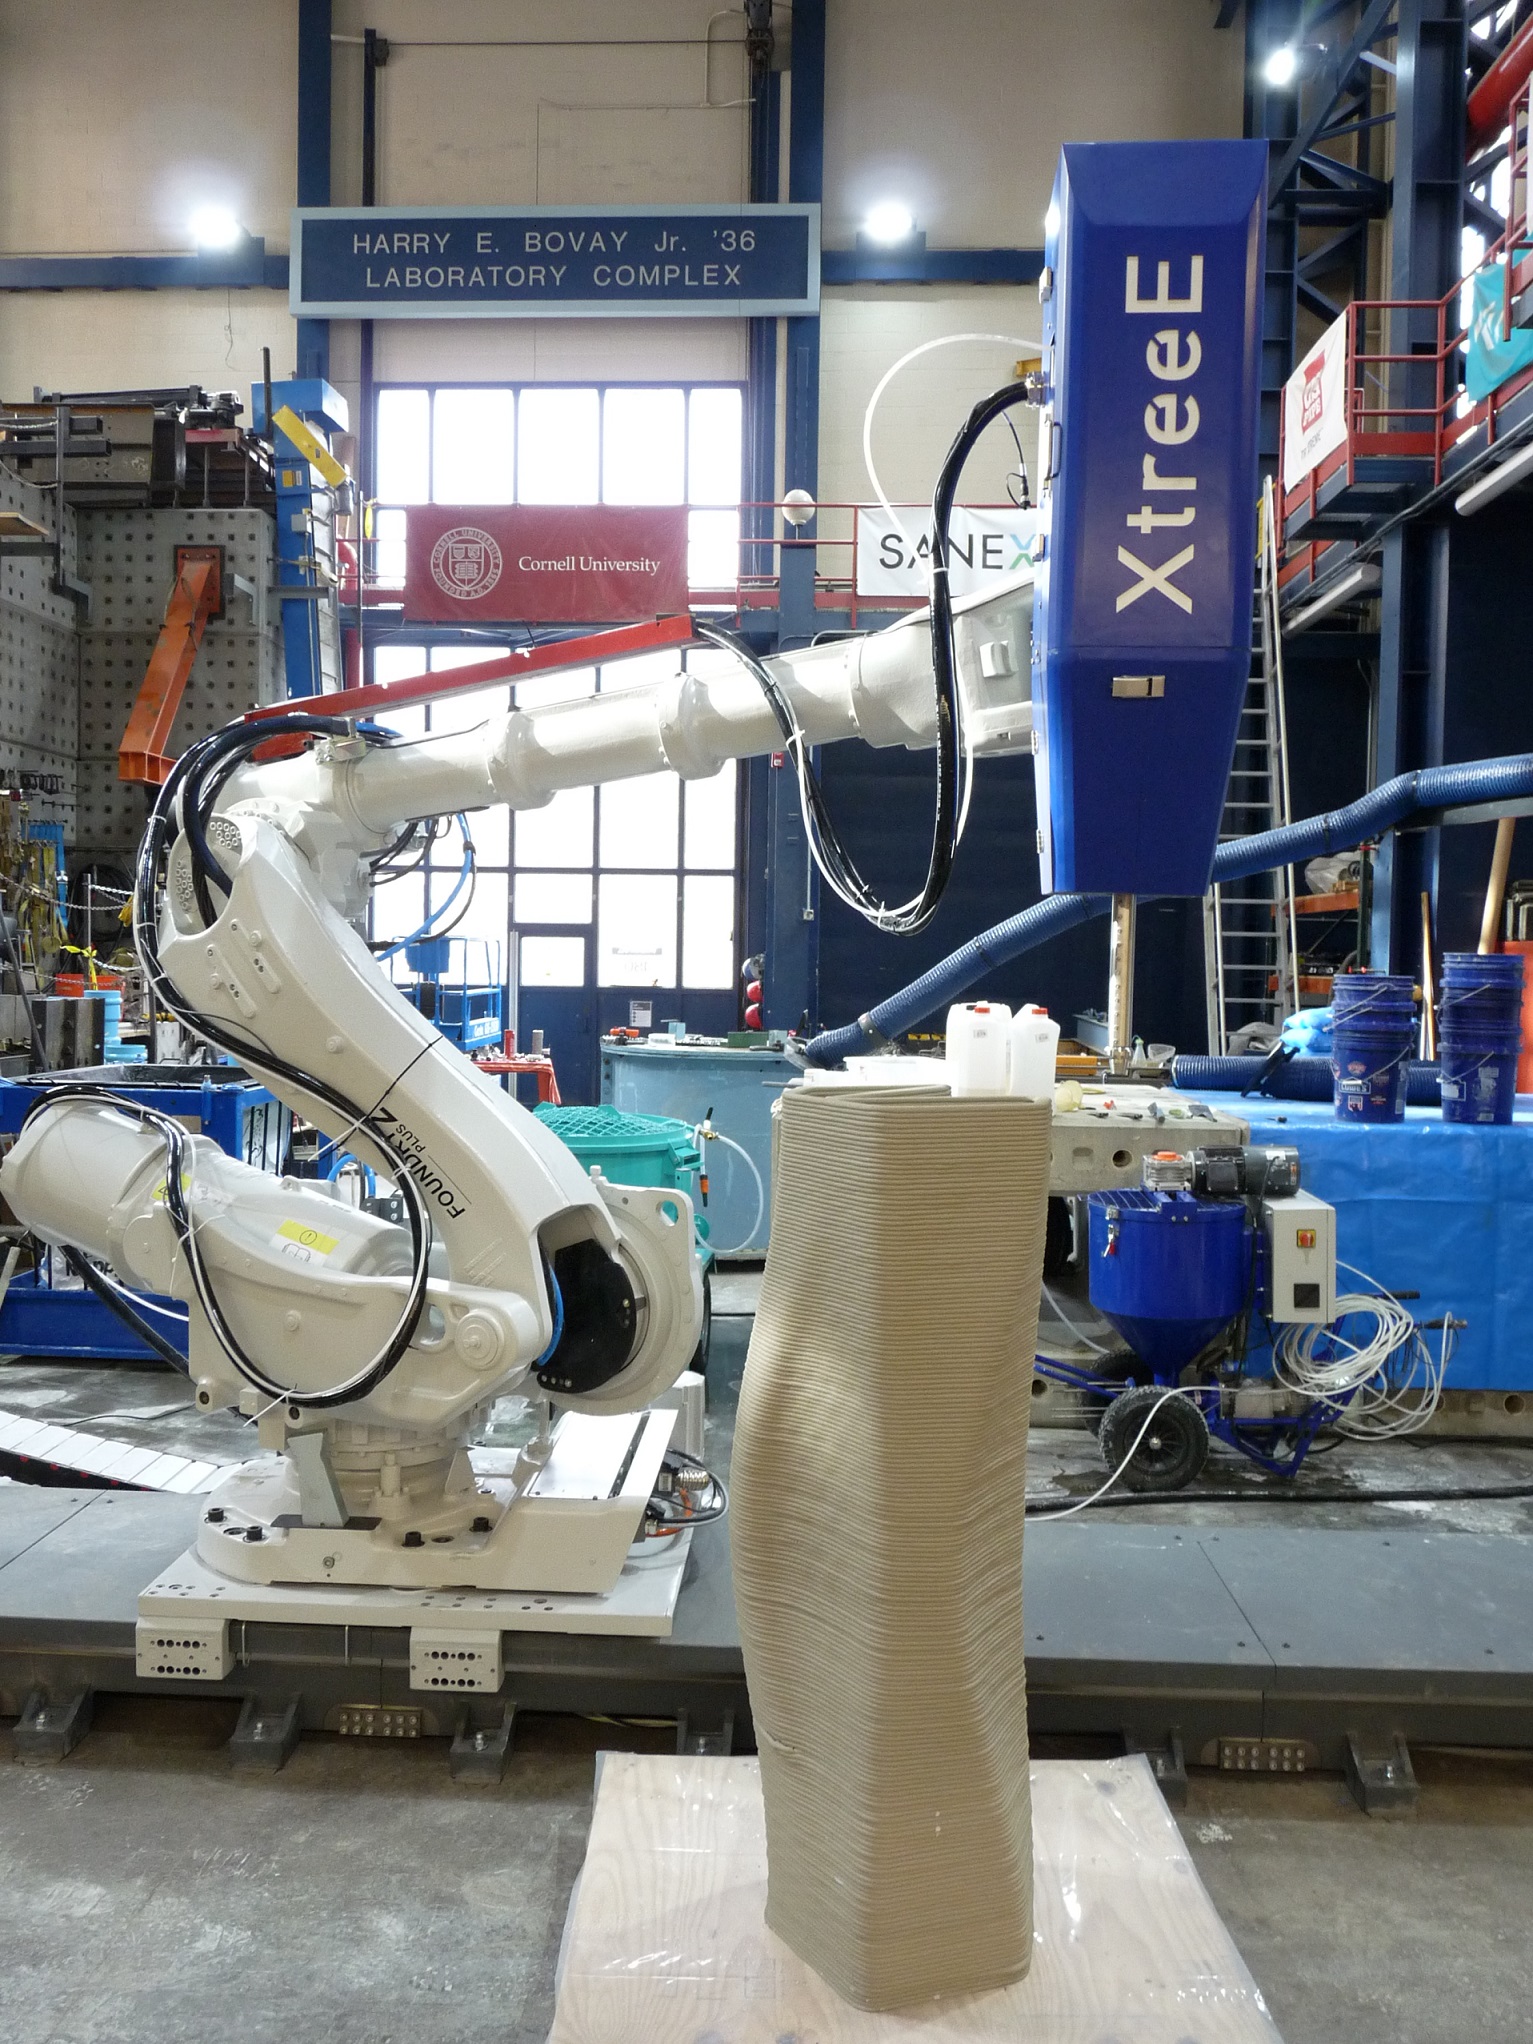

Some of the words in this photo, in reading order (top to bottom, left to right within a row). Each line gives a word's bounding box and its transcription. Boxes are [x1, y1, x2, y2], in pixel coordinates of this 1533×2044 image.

[353, 232, 451, 254] HARRY
[476, 232, 500, 253] E.
[524, 231, 628, 253] BOVAY
[654, 231, 687, 252] Jr.
[713, 230, 756, 251] '36
[366, 265, 567, 288] LABORATORY
[593, 264, 741, 286] COMPLEX
[1116, 255, 1204, 614] XtreeE
[879, 533, 1036, 570] SANEX
[518, 556, 575, 572] Cornell
[579, 556, 661, 576] University
[395, 1124, 427, 1153] PLUS
